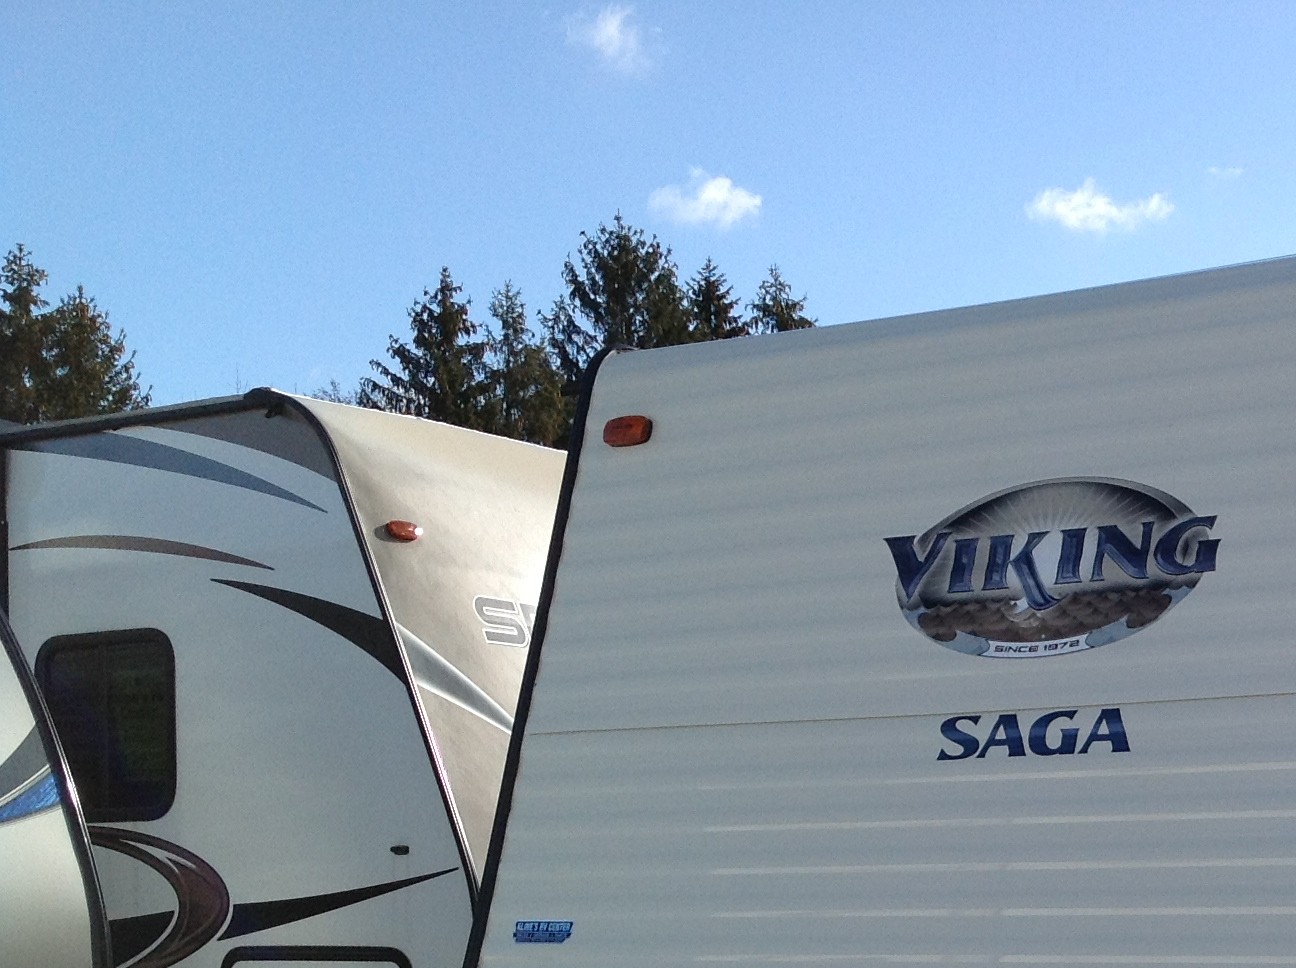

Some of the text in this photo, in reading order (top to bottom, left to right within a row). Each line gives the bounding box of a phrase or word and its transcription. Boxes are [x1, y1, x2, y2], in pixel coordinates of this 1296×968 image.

[883, 514, 1222, 611] VIKING
[993, 639, 1080, 653] SINCE 1972
[936, 708, 1131, 761] SAGA
